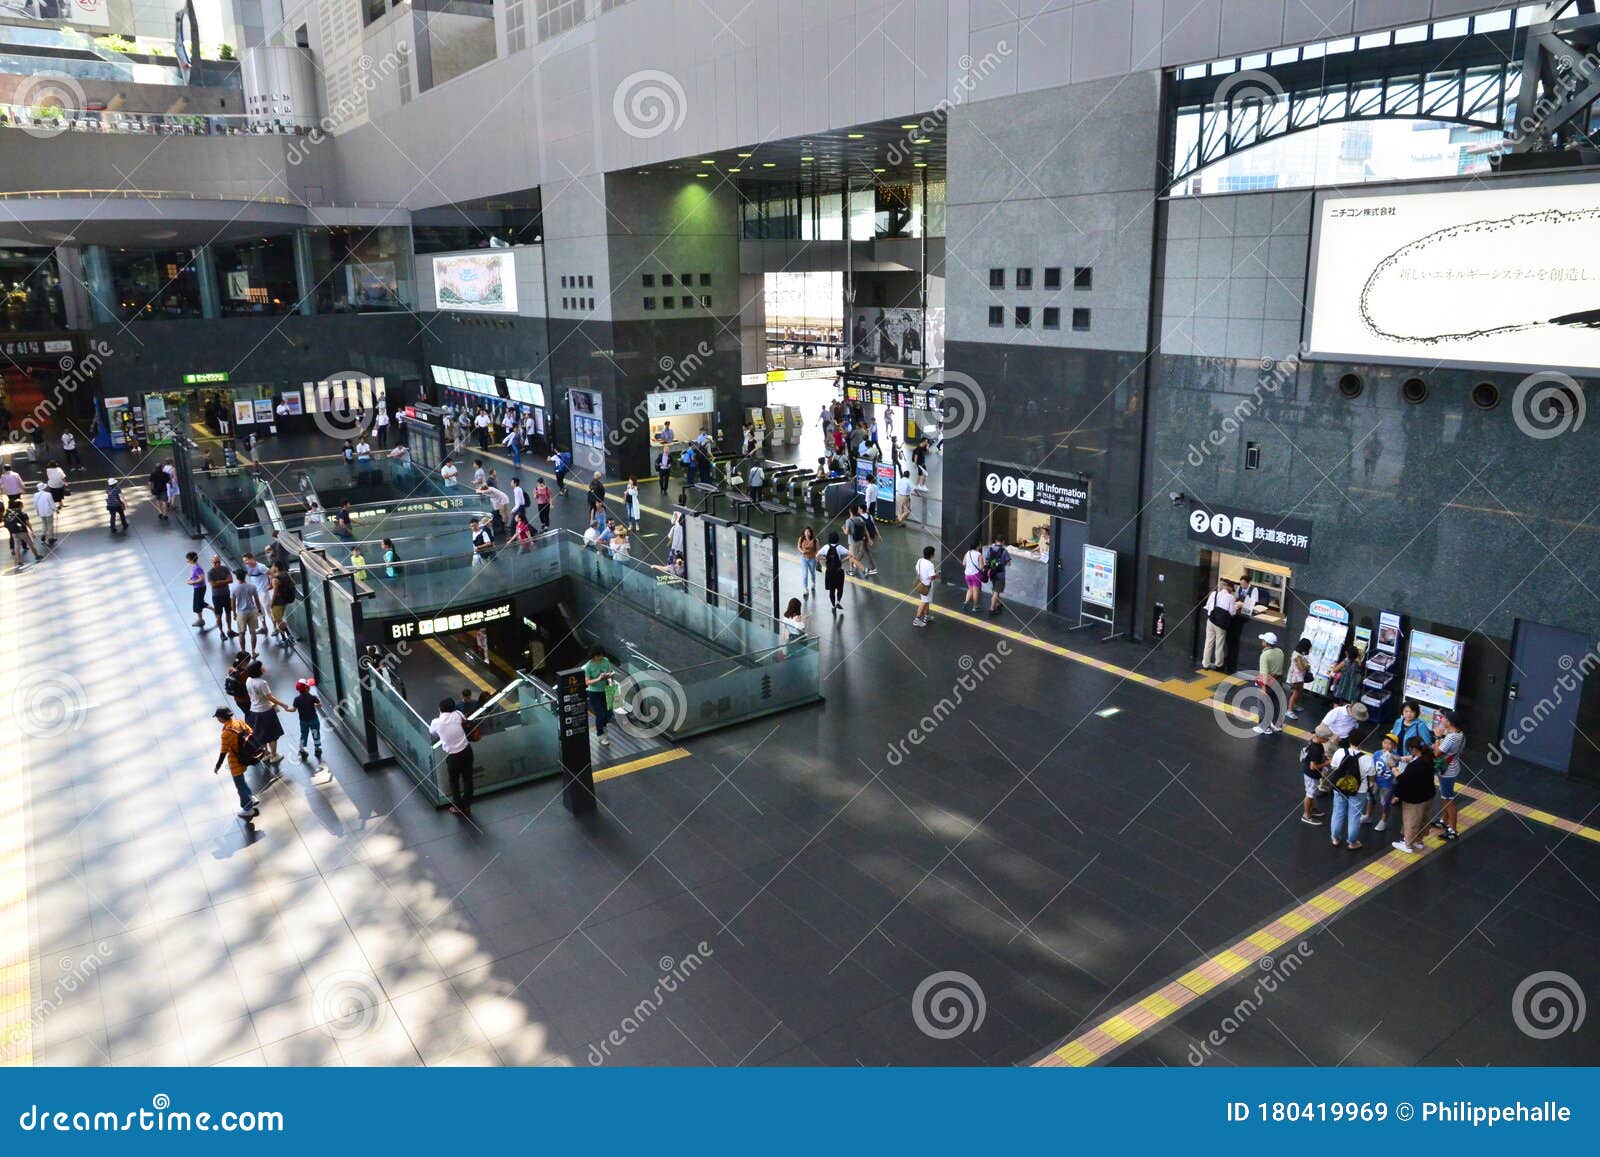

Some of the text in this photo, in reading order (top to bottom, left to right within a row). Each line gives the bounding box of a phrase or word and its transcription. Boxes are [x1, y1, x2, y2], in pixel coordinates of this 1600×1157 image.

[1330, 206, 1397, 218] ニチコン株式会社
[1036, 481, 1087, 500] JR Information
[1254, 526, 1308, 549] 鉄道案内所
[391, 622, 414, 639] B1F
